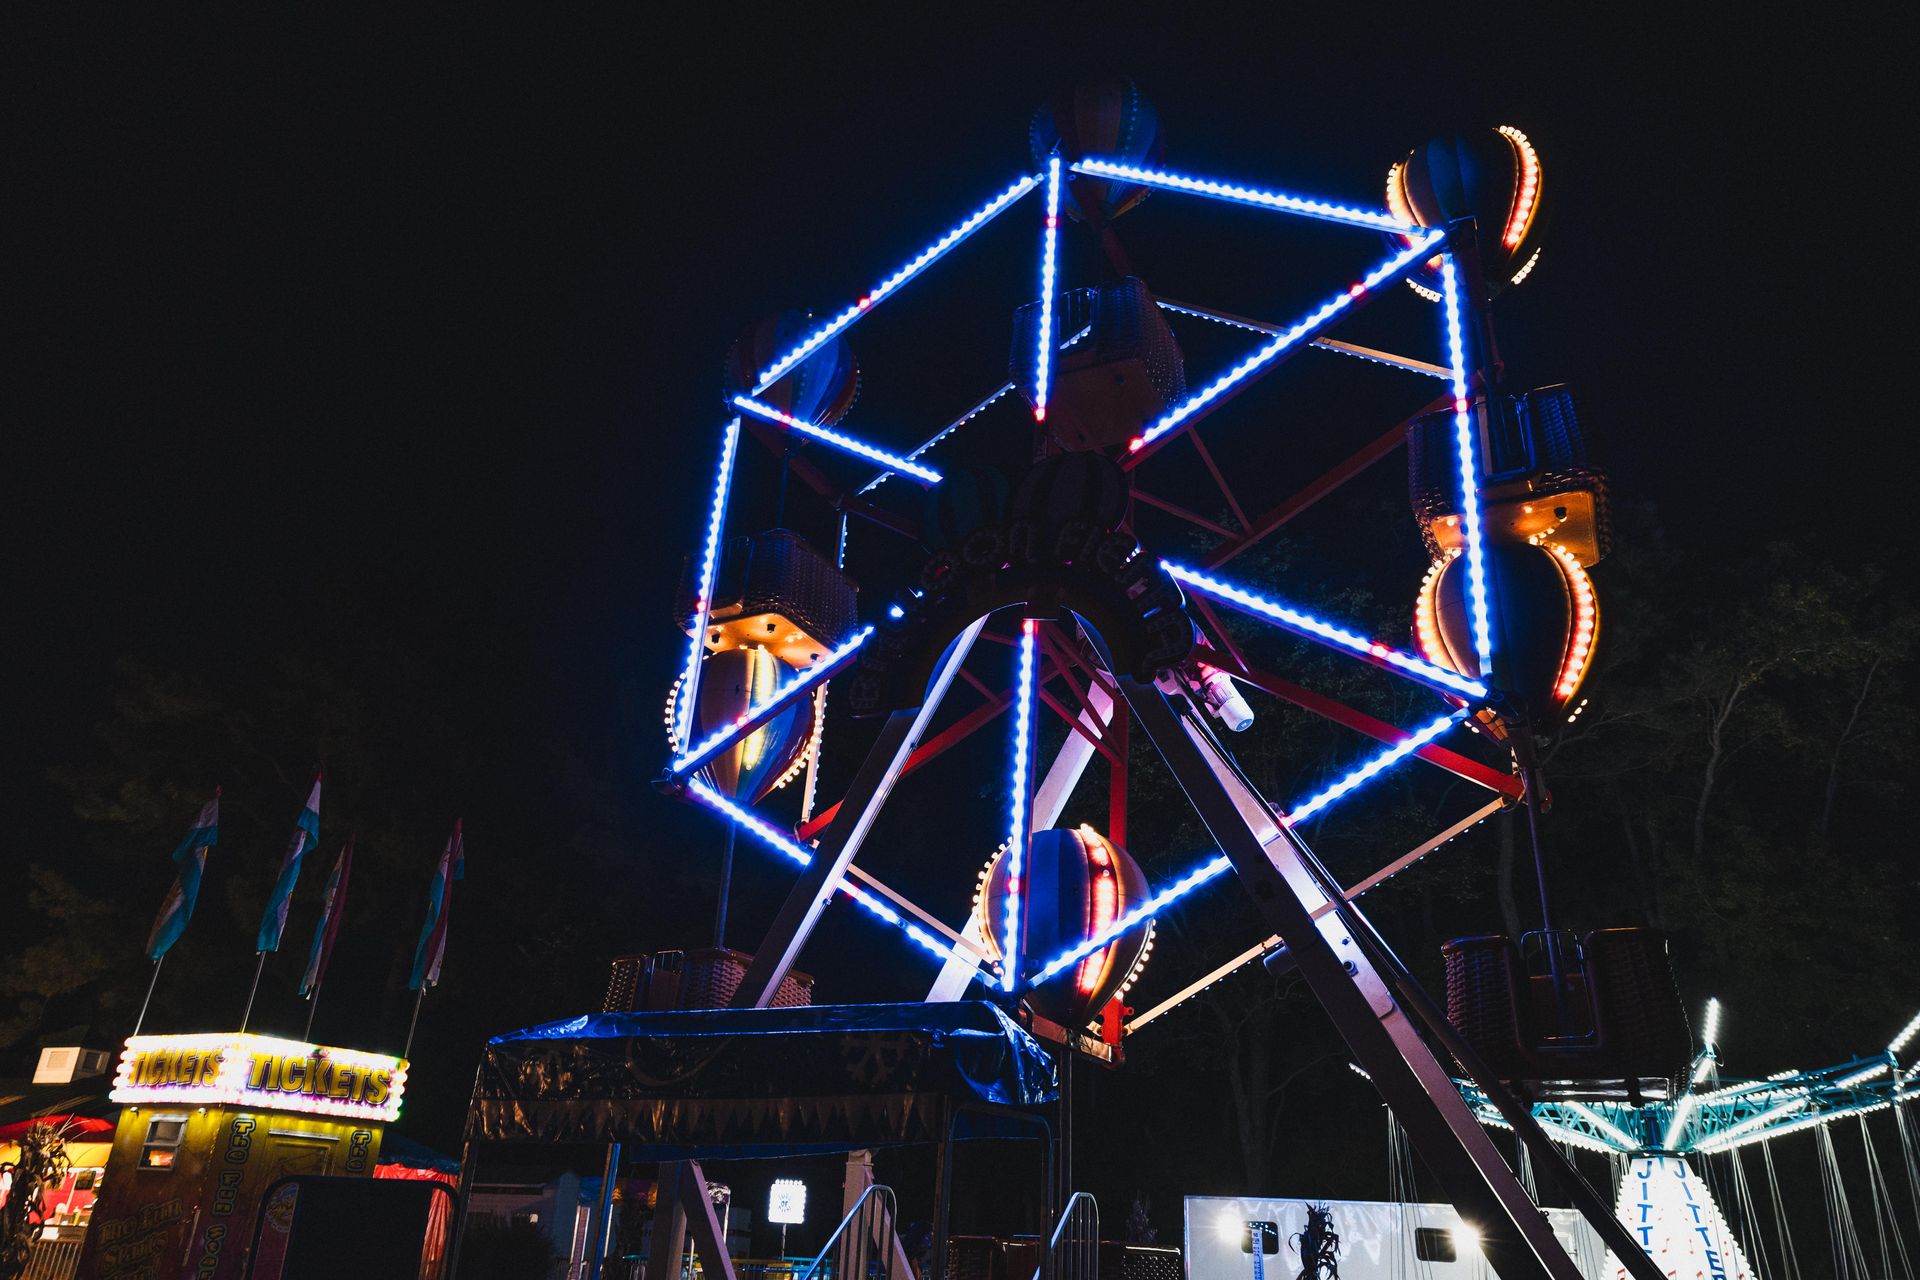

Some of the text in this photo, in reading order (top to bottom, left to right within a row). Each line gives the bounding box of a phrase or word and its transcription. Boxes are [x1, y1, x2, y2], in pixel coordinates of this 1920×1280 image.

[128, 1048, 224, 1088] TICKETS
[248, 1053, 391, 1105] TICKETS
[1637, 1161, 1653, 1254] JITT
[1673, 1160, 1728, 1280] JITTE
